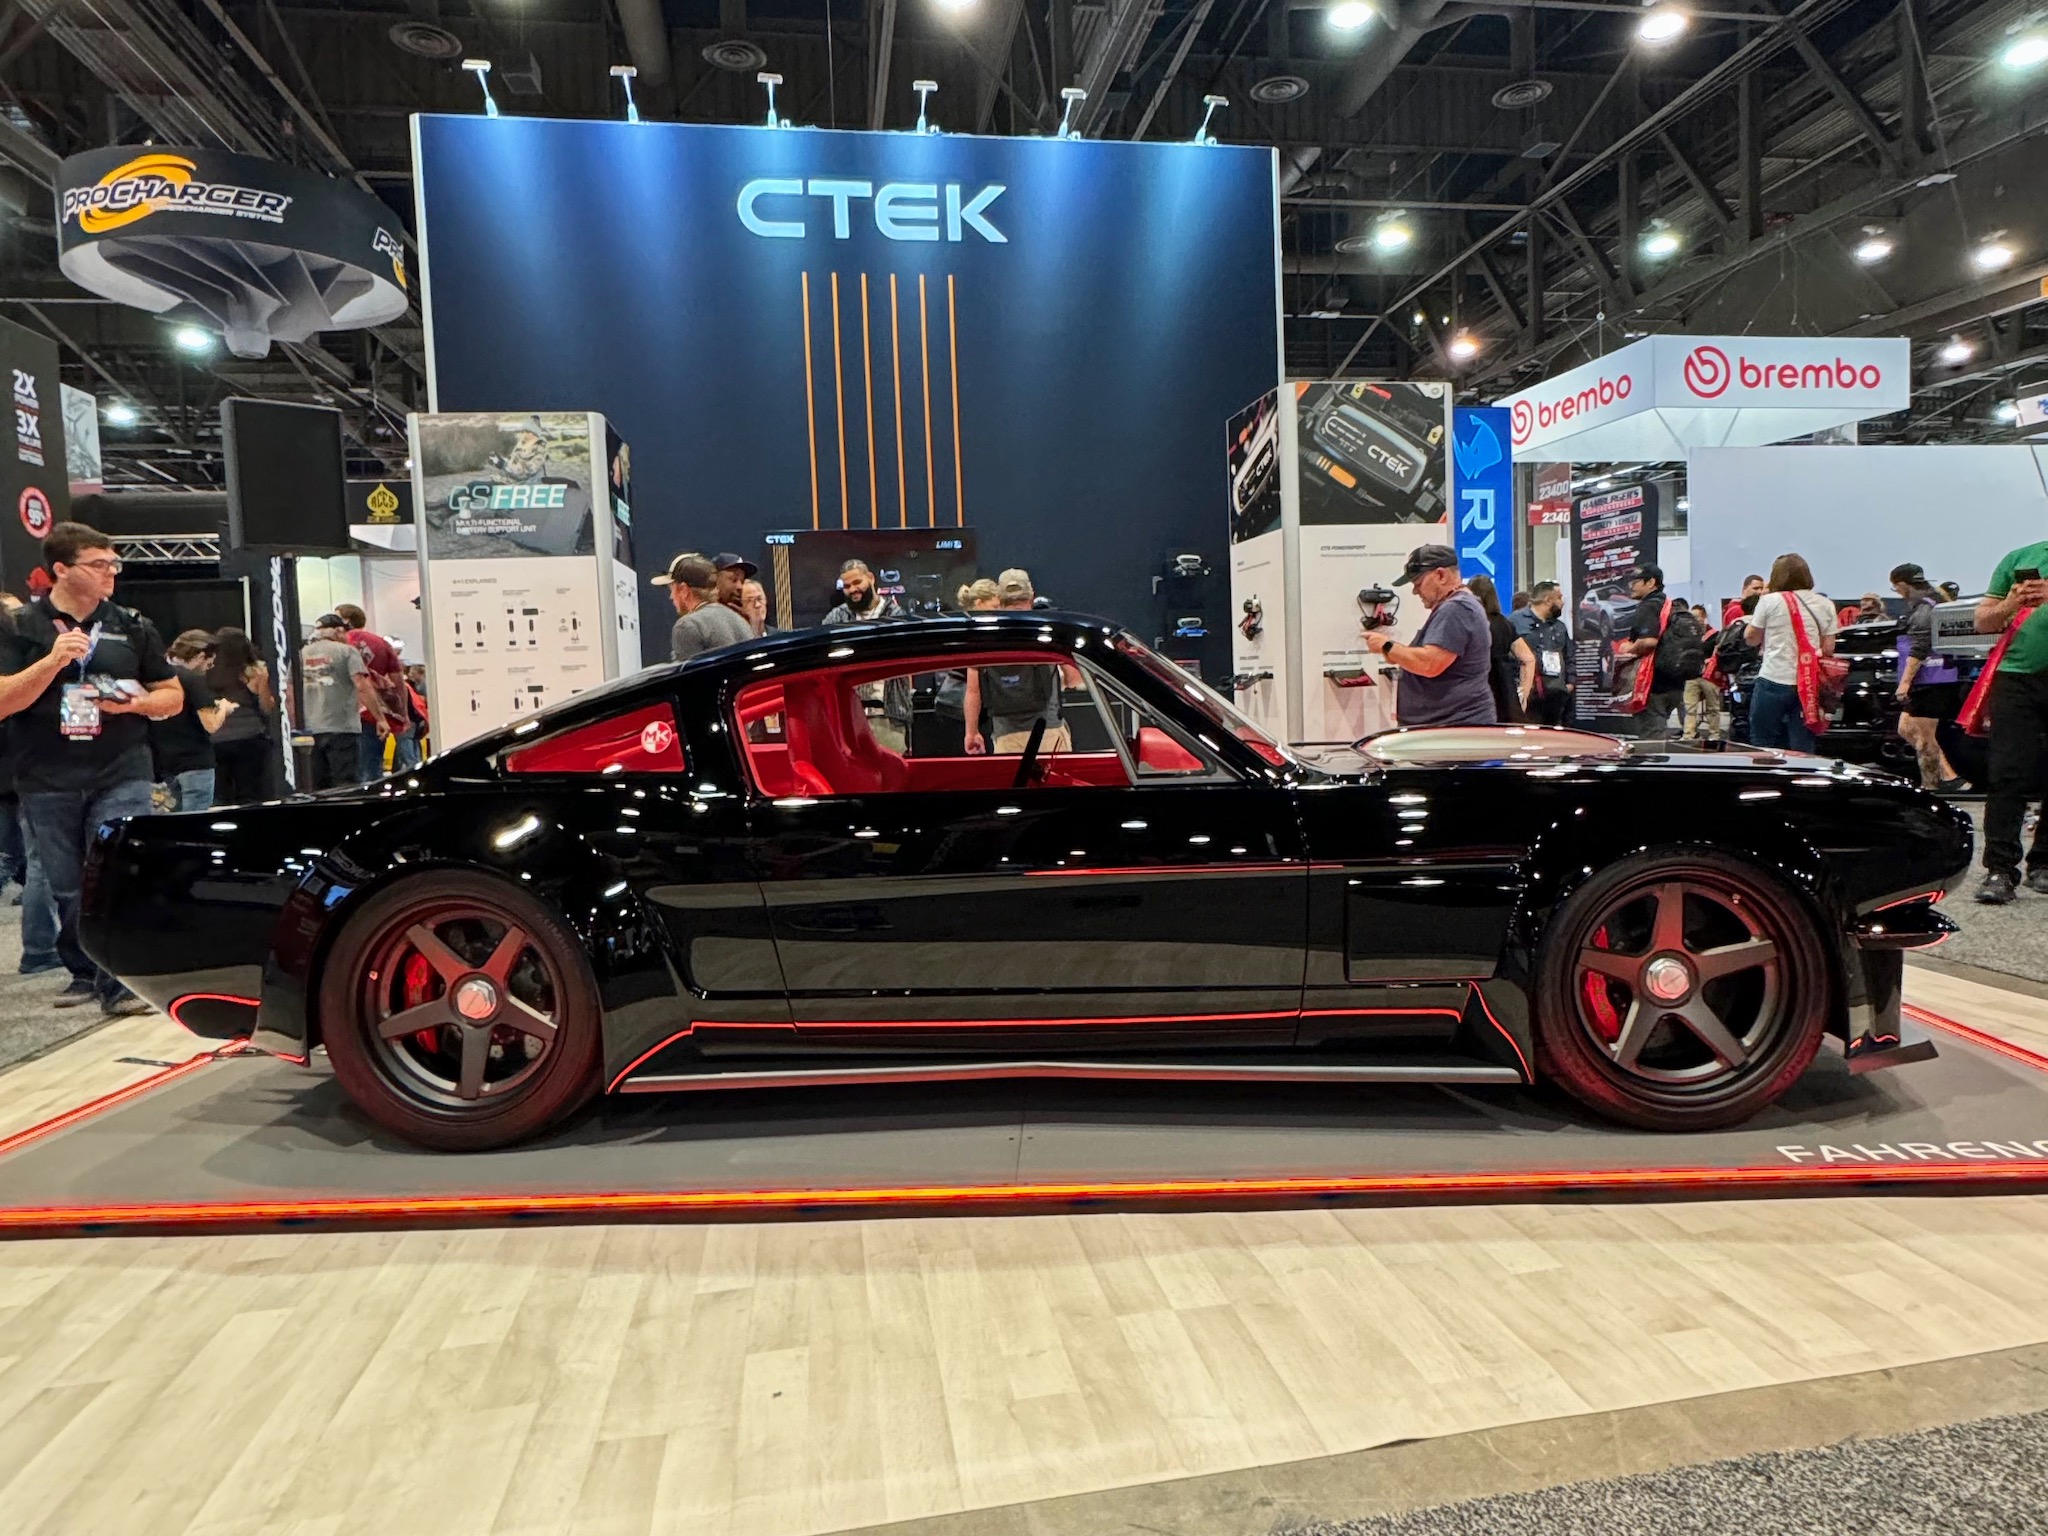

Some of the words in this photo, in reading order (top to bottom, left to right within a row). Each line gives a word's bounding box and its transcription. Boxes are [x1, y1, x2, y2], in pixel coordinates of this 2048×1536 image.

[737, 179, 1009, 243] CTEK
[12, 369, 37, 398] 2X
[1739, 356, 1881, 389] brembo
[1538, 374, 1632, 428] brembo
[15, 409, 41, 439] 3X
[1367, 444, 1410, 478] CTEK
[766, 535, 795, 545] CTEK
[645, 730, 669, 743] MK
